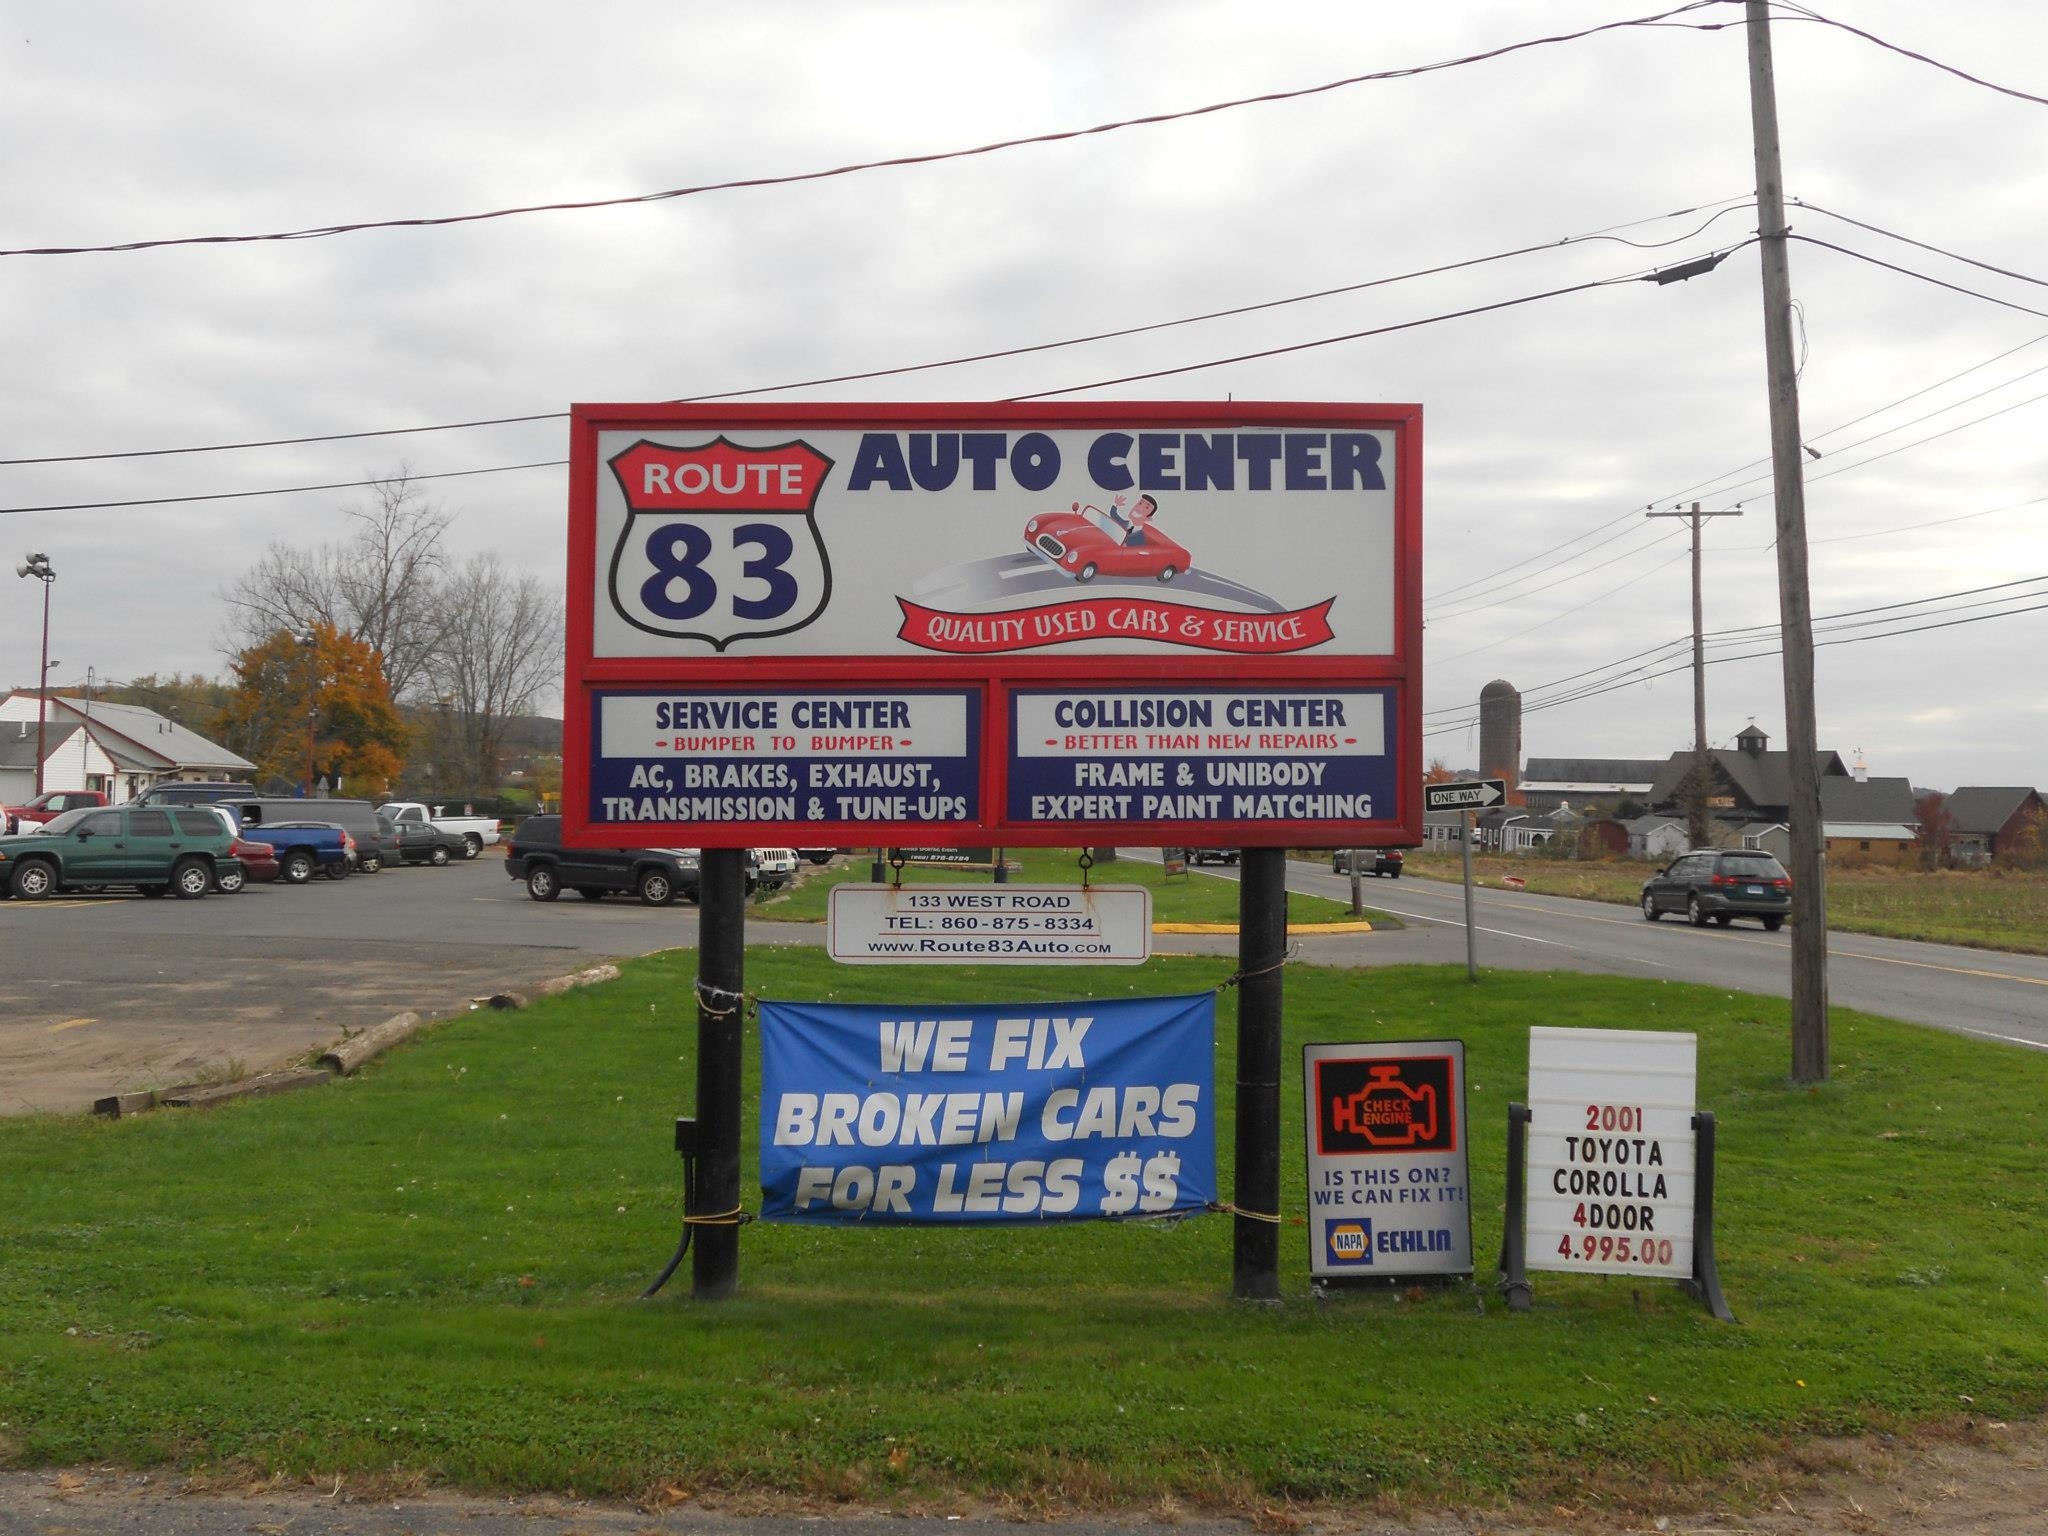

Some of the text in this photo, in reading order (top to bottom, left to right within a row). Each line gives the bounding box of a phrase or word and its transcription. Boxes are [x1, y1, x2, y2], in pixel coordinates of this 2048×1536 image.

[847, 432, 1387, 492] AUTO CENTER
[644, 463, 803, 495] ROUTE
[640, 523, 798, 620] 83
[927, 608, 1306, 643] QUALITY USED CARS & SERVICE
[656, 701, 911, 729] SERVICE CENTER
[1054, 700, 1347, 728] COLLISION CENTER
[674, 736, 893, 752] BUMPER TO BUMPER
[1065, 734, 1339, 750] BETTER THAN NEW REPAIRS
[629, 764, 941, 794] AC, BRAKES, EXHAUST,
[1075, 762, 1327, 787] FRAME & UNIBODY
[602, 796, 967, 822] TRANSMISSION & TUNE-UPS
[1032, 794, 1372, 820] EXPERT PAINT MATCHING
[1434, 790, 1480, 803] ONE WAY
[909, 896, 1070, 908] 133 WEST ROAD
[885, 917, 933, 929] TEL:
[880, 1017, 1094, 1073] WE FIX
[774, 1084, 1200, 1147] BROKEN CARS
[1363, 1100, 1411, 1113] CHECK
[1363, 1112, 1413, 1125] ENGINE
[1586, 1105, 1643, 1132] 2001
[1566, 1136, 1662, 1166] TOYOTA
[795, 1151, 1181, 1217] FOR LESS $$
[1324, 1168, 1450, 1186] IS THIS ON?
[1553, 1168, 1667, 1199] COROLLA
[1314, 1187, 1464, 1205] WE CAN FIX IT!
[1336, 1234, 1363, 1250] NAPA
[1377, 1230, 1452, 1253] ECHLIN
[1558, 1234, 1672, 1265] 4.995.00
